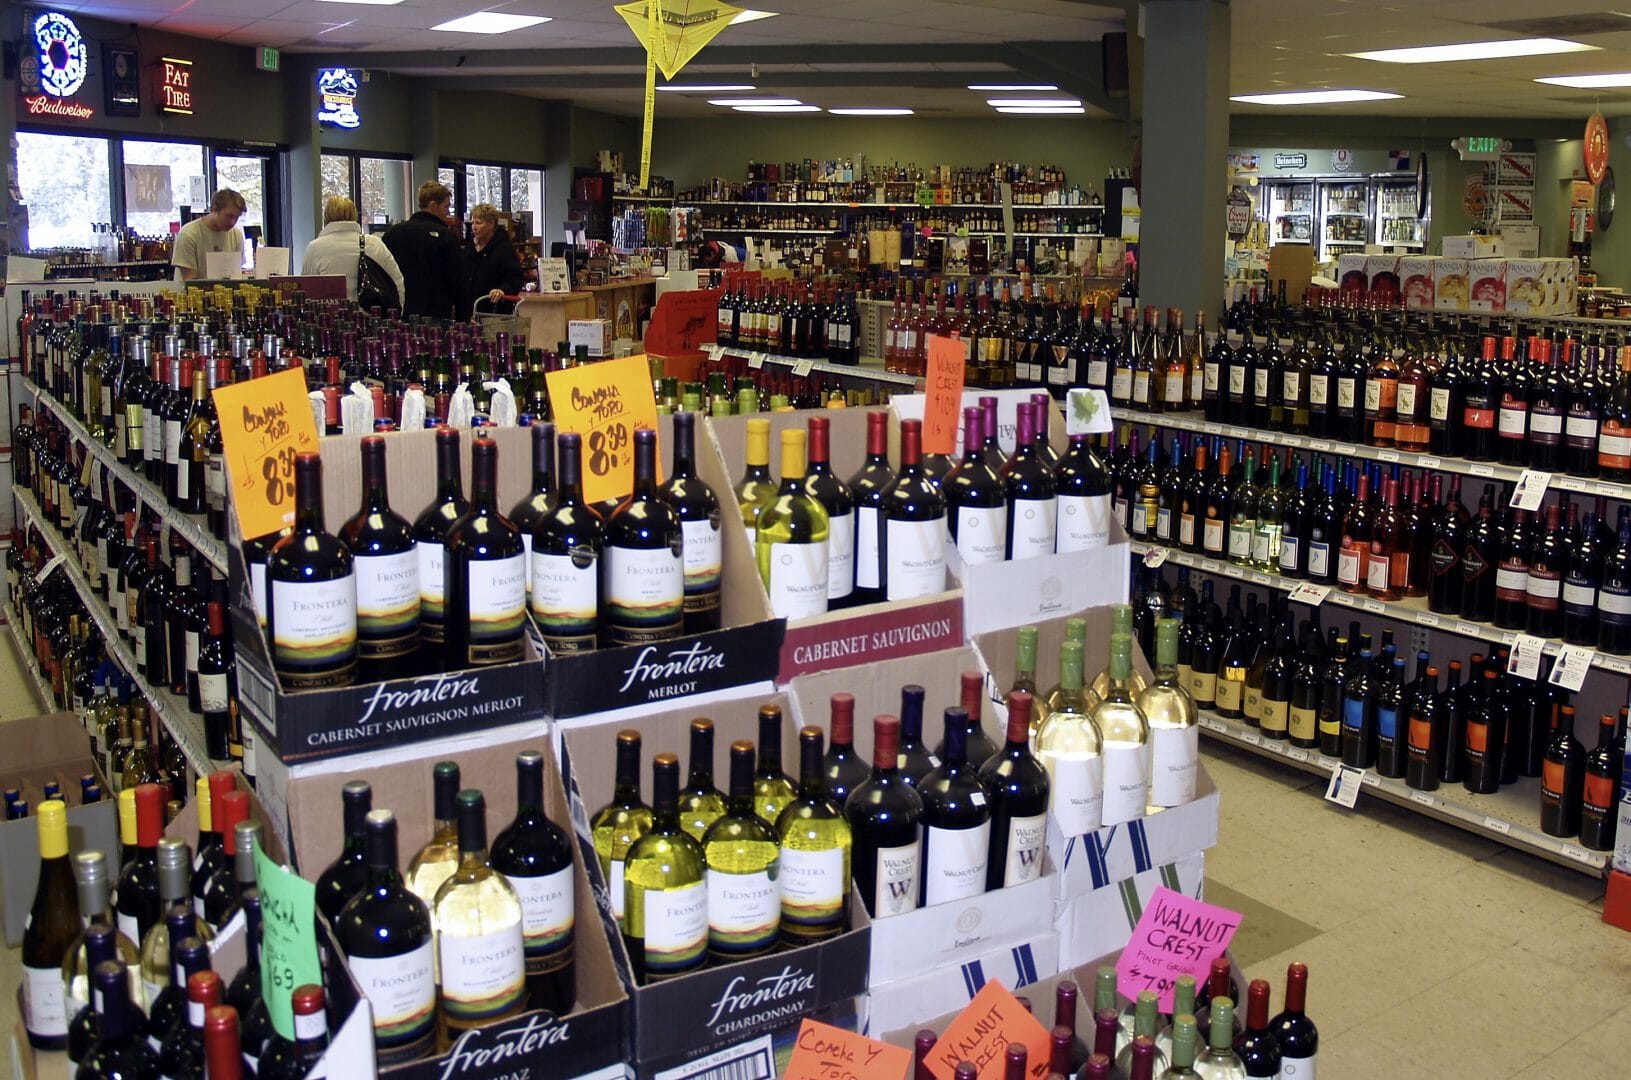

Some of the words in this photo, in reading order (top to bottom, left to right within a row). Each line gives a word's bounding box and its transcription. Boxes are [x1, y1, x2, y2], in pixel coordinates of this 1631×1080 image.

[263, 47, 279, 69] EXIT
[164, 64, 190, 87] FAT
[26, 96, 94, 118] Budweiser
[163, 86, 191, 107] TIRE
[1469, 137, 1498, 153] EXIT
[1275, 156, 1303, 166] Heineken
[684, 535, 717, 545] ONTERA
[627, 565, 676, 575] FRONTERA
[293, 598, 348, 611] FRONTERA
[793, 635, 868, 665] CABERNET
[872, 619, 951, 650] SAUVIGNON
[619, 641, 725, 693] frontera
[358, 671, 480, 724] frontera
[648, 681, 697, 700] MERLOT
[307, 722, 383, 746] CABERNET
[386, 707, 468, 733] SAUVIGNON
[471, 696, 524, 715] MERLOT
[883, 856, 916, 869] WALNUT
[1018, 847, 1040, 867] W
[781, 865, 826, 877] RONTERA
[888, 865, 913, 877] CREST
[522, 890, 562, 905] ONTERA
[723, 887, 773, 900] FRONTERA
[888, 879, 912, 898] W
[1154, 899, 1236, 944] WALNUT
[462, 945, 517, 965] FRONTERA
[1146, 929, 1210, 962] CREST
[1137, 950, 1163, 966] PINOT
[372, 967, 429, 989] FRONTERA
[706, 965, 815, 1027] frontera
[715, 999, 806, 1036] CHARDONNAY
[439, 1015, 570, 1080] frontera
[940, 1003, 1004, 1071] WALNUT
[975, 1030, 1009, 1073] REST
